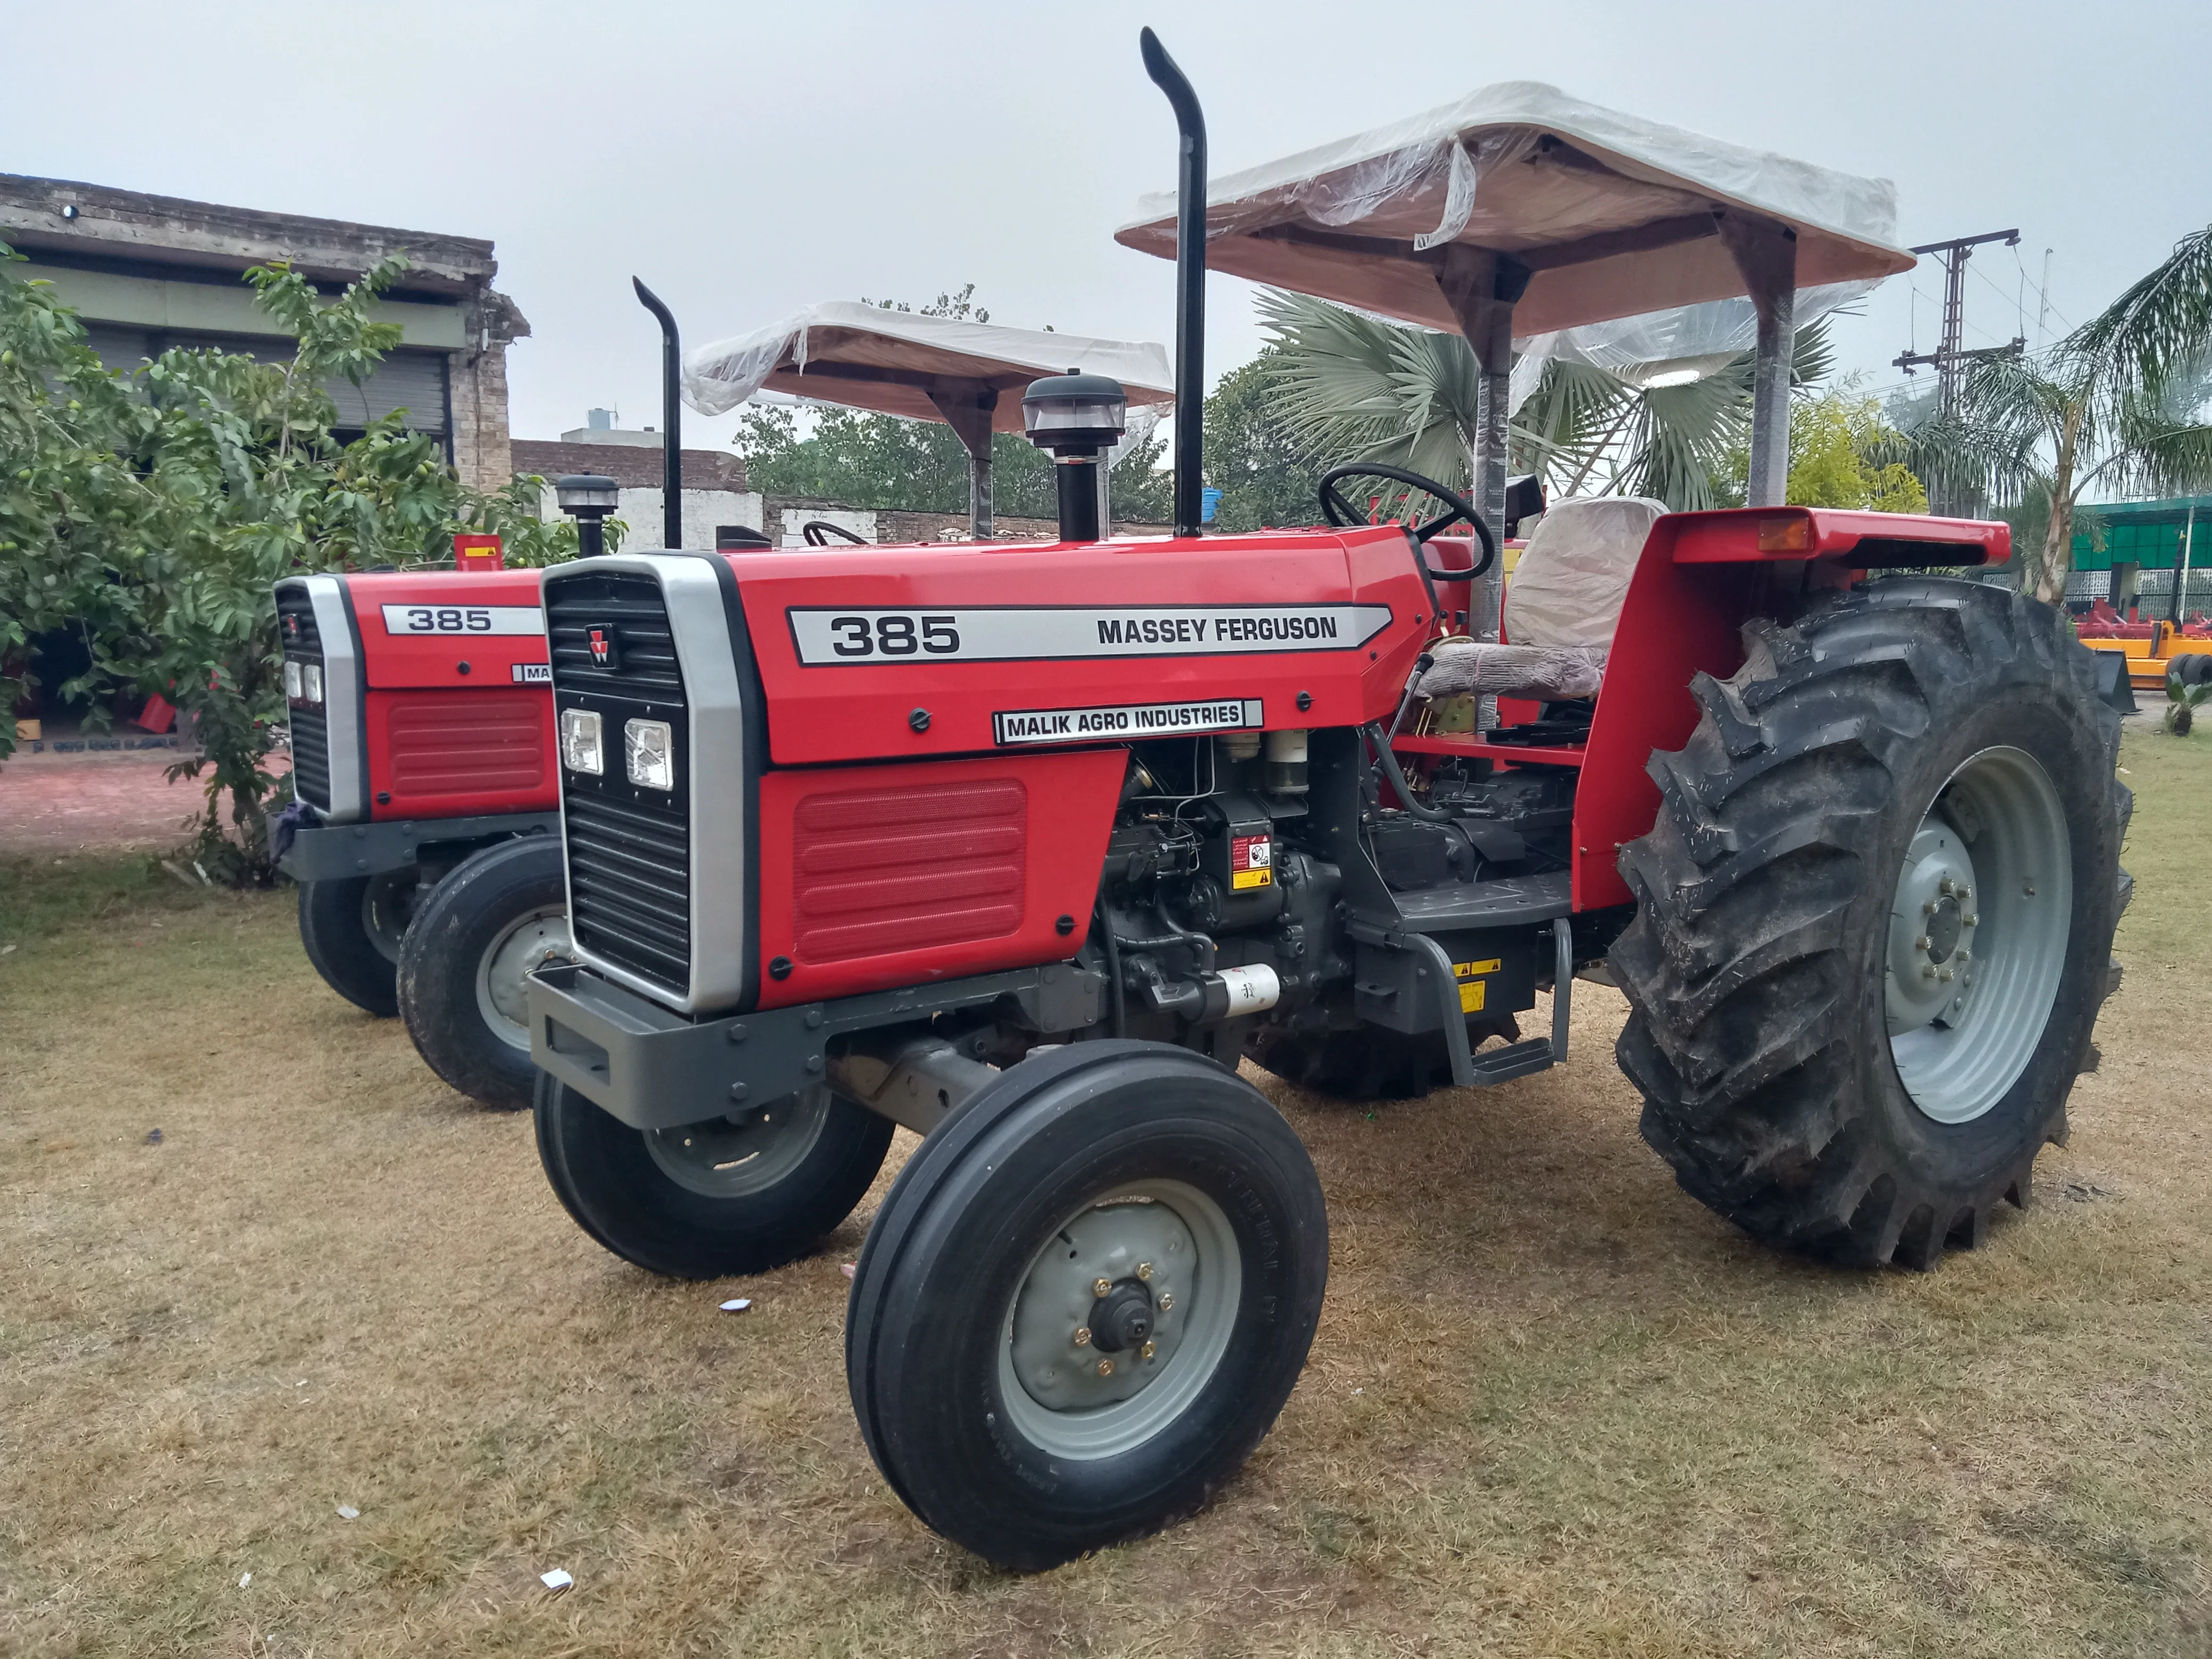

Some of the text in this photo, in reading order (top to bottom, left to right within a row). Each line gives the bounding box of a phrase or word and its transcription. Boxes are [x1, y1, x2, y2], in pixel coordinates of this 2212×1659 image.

[407, 610, 491, 631] 385
[1097, 617, 1338, 644] MASSEY FERGUSON
[831, 616, 960, 657] 385
[1007, 705, 1239, 738] MALIK AGRO INDUSTRIES
